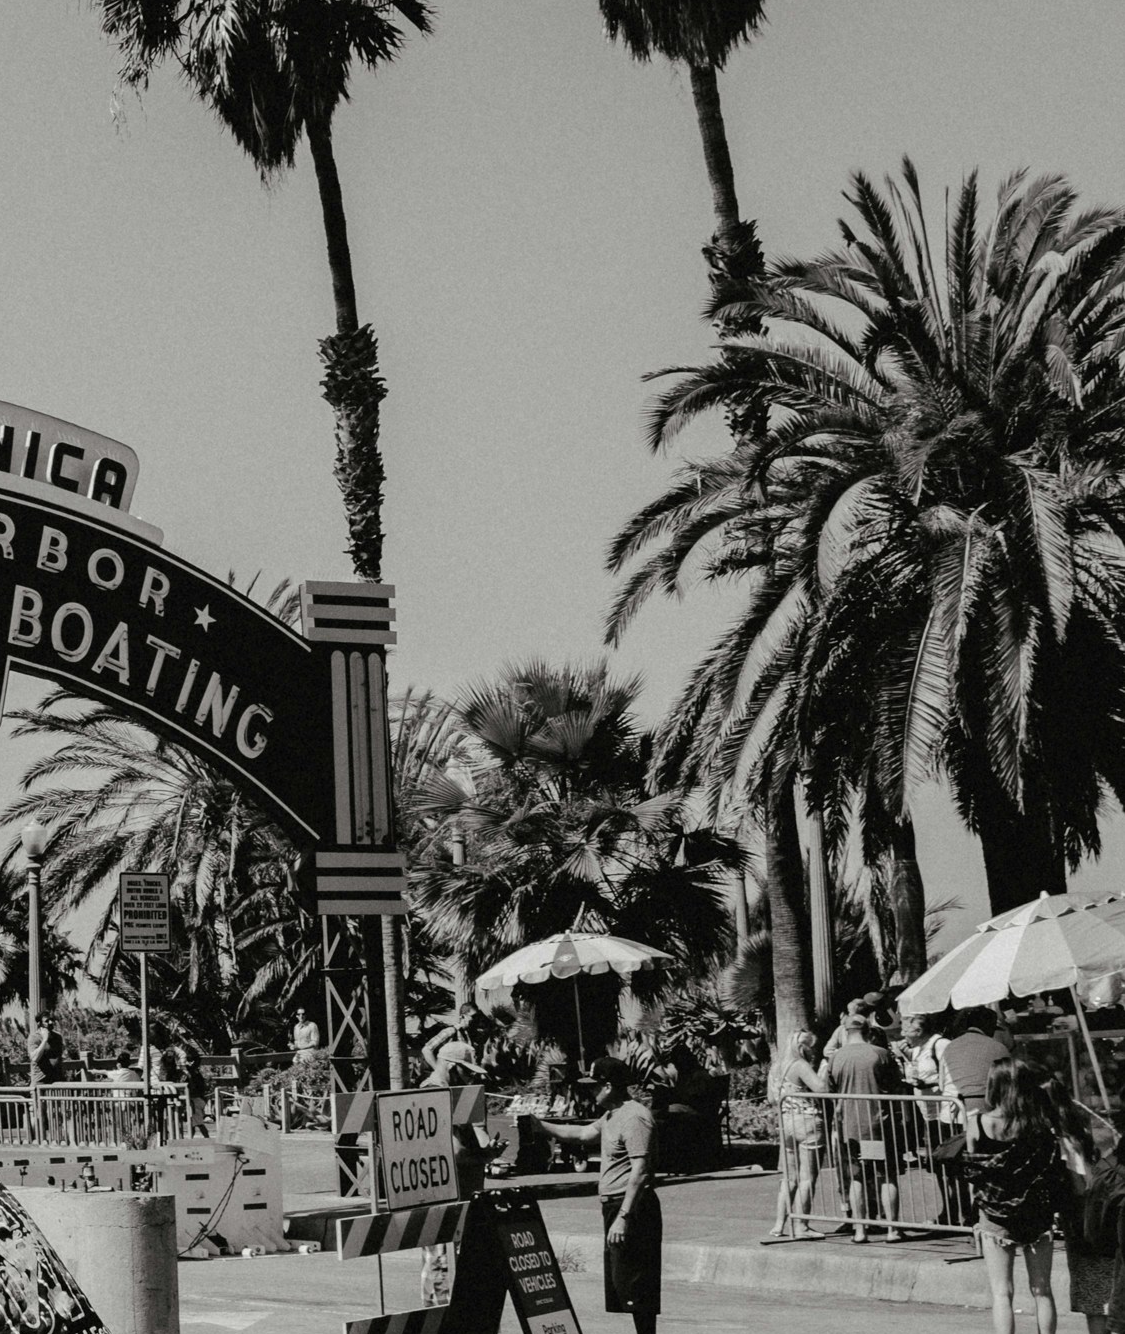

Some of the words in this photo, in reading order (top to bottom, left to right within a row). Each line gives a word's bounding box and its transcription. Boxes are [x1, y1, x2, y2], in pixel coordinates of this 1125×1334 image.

[7, 584, 274, 759] BOATING
[123, 910, 167, 920] PROHIBITED
[392, 1107, 438, 1142] ROAD
[390, 1154, 450, 1194] CLOSED
[510, 1231, 535, 1248] ROAD
[509, 1253, 541, 1272] CLOSED
[538, 1251, 552, 1267] TO
[518, 1273, 557, 1294] VEHICLES
